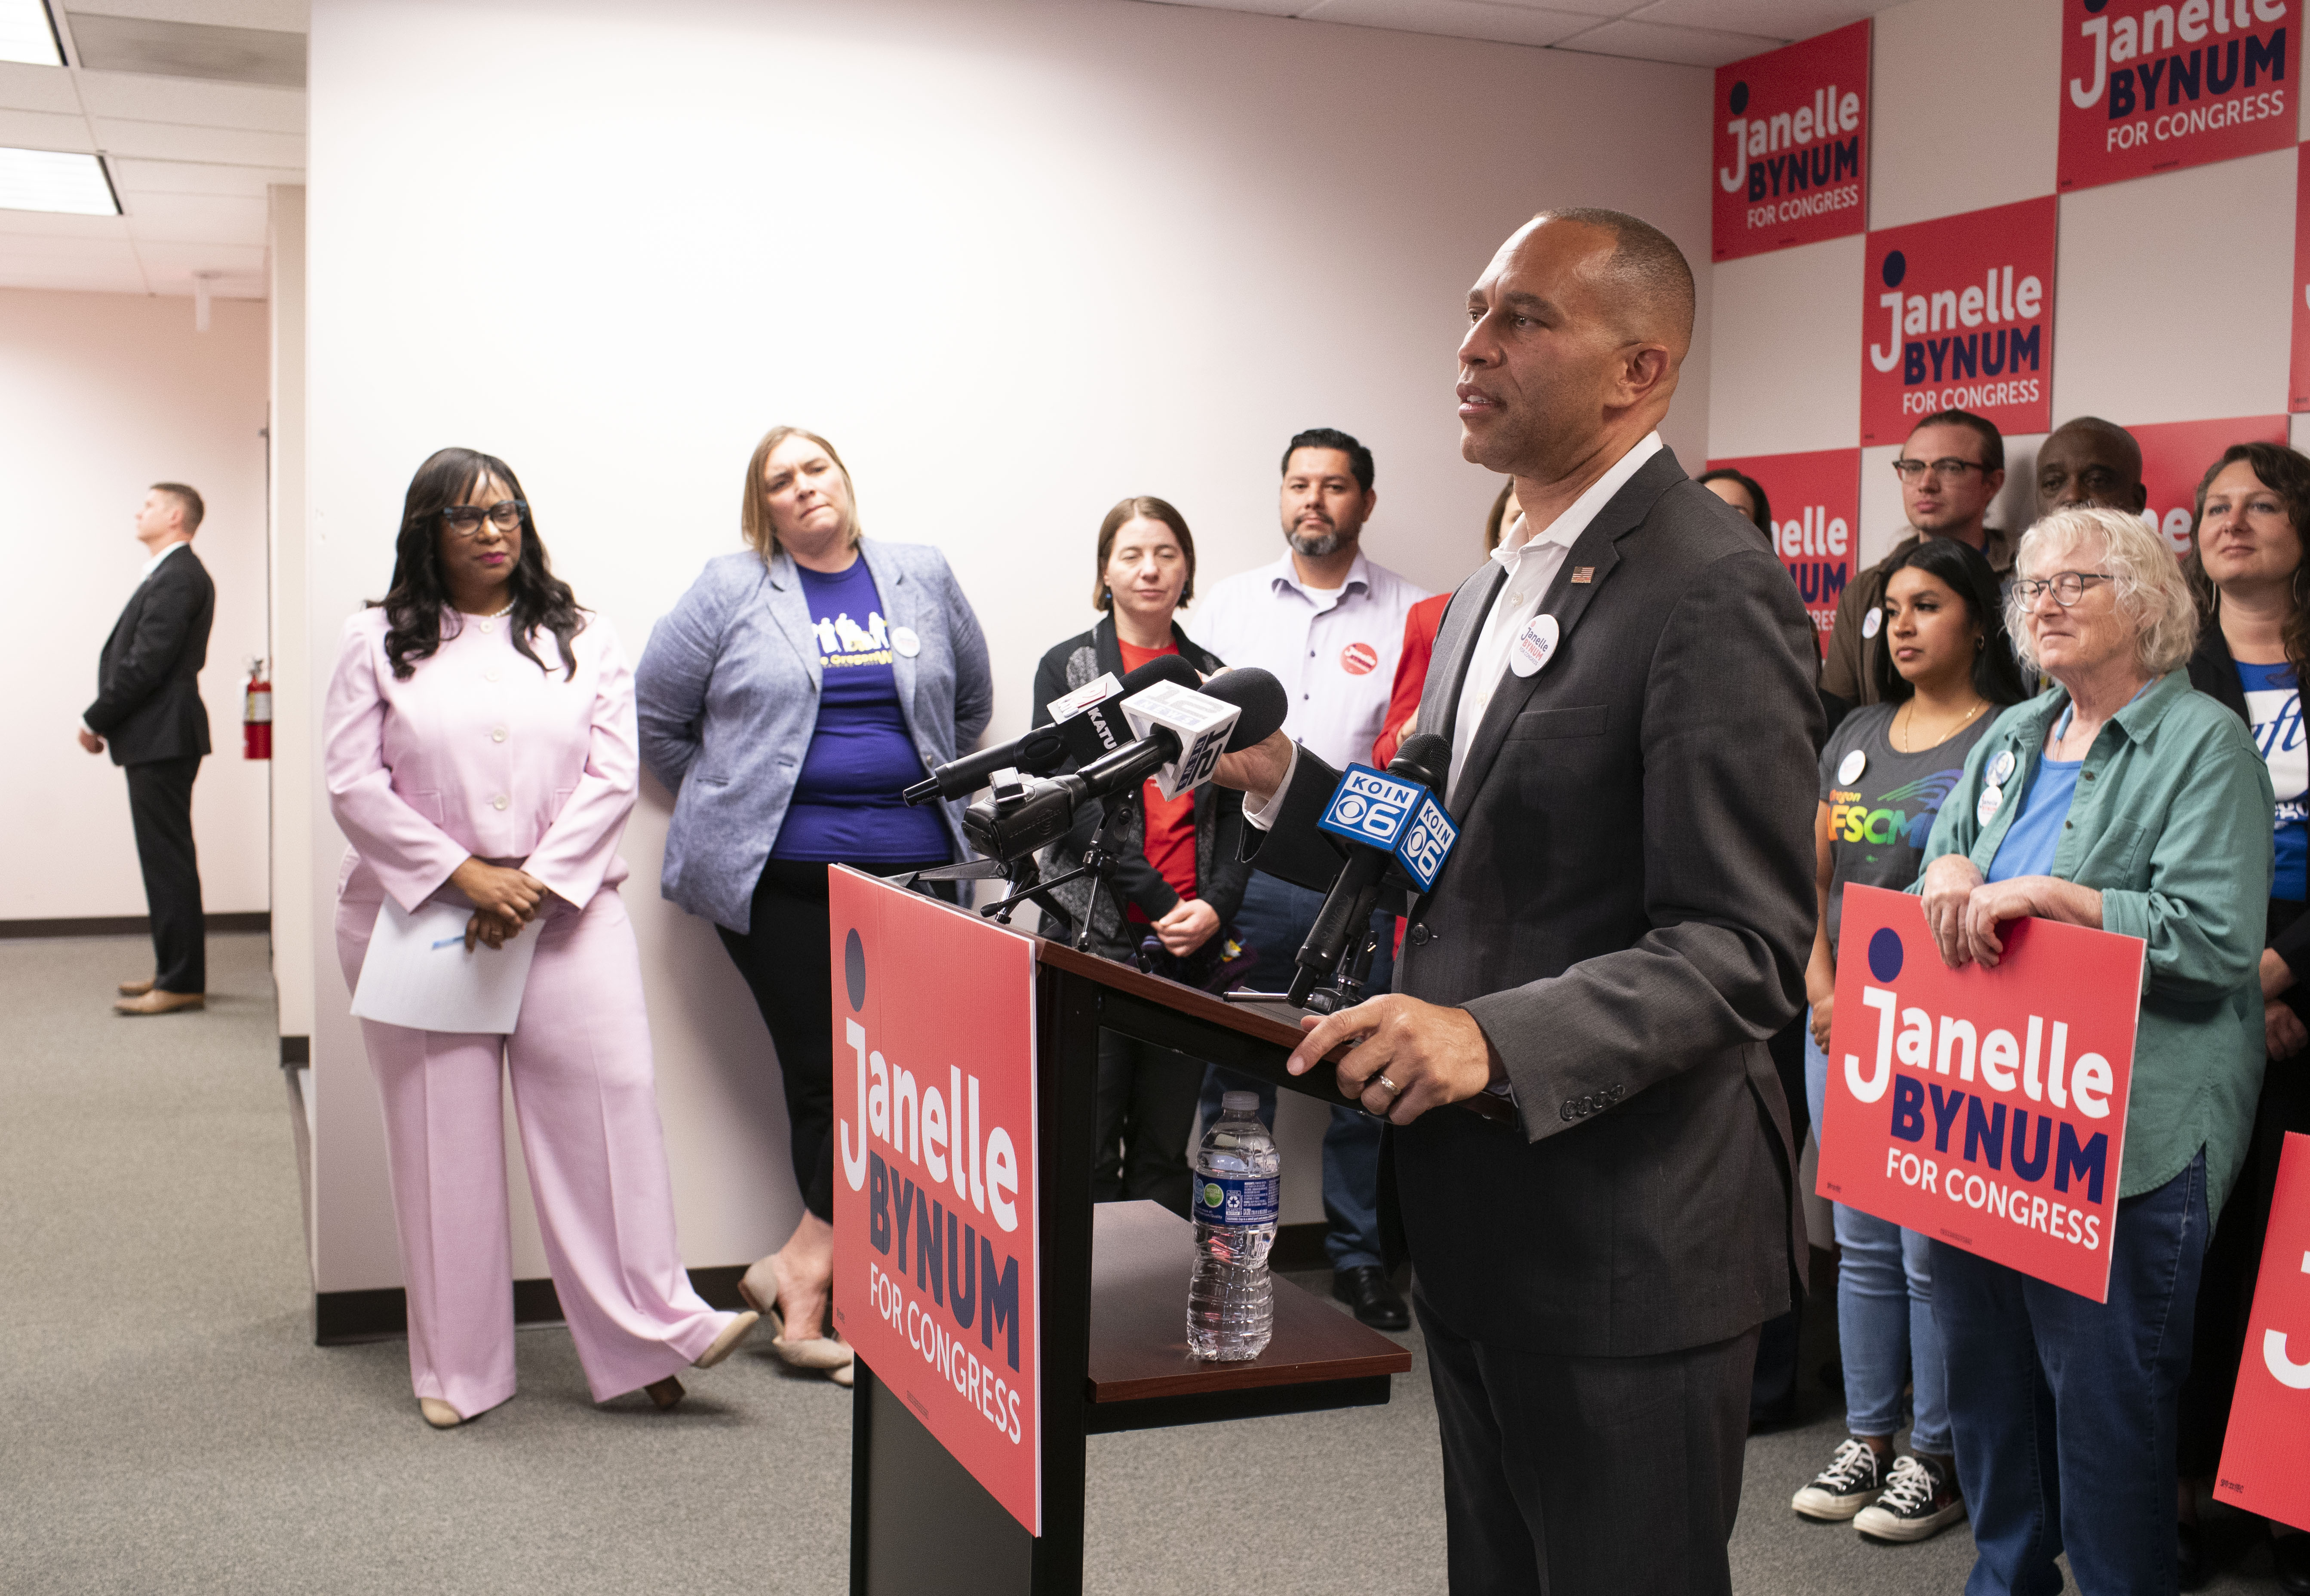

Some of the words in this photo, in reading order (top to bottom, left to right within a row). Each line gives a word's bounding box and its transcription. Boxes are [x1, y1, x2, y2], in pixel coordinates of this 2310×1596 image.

[2110, 28, 2286, 119] BYNUM
[1721, 82, 1859, 192] Janelle
[2107, 122, 2148, 152] FOR
[2155, 90, 2284, 140] CONGRESS
[1749, 137, 1858, 202] BYNUM
[1748, 205, 1776, 228] FOR
[1779, 185, 1858, 222] CONGRESS
[1871, 251, 2042, 372] Janelle
[1905, 325, 2040, 385] BYNUM
[1903, 388, 1937, 414] FOR
[1941, 379, 2039, 411] CONGRESS
[1521, 621, 1548, 652] Janelle
[1522, 638, 1544, 661] BYNUM
[1524, 651, 1539, 666] CONGRESS
[1087, 707, 1117, 750] KATU
[1138, 700, 1195, 724] NEWS
[1145, 685, 1225, 720] 12
[1179, 742, 1204, 787] NEWS
[1187, 720, 1234, 786] 12
[1352, 776, 1410, 804] KOIN
[1362, 803, 1401, 837] 6
[1423, 806, 1451, 845] KOIN
[1418, 839, 1442, 877] 6
[1844, 928, 2113, 1118] Janelle
[840, 929, 1018, 1232] Janelle
[1891, 1074, 2108, 1204] BYNUM
[1887, 1147, 1938, 1194] FOR
[1945, 1168, 2100, 1250] CONGRESS
[871, 1152, 1020, 1373] BYNUM
[871, 1262, 903, 1336] FOR
[908, 1301, 1022, 1445] CONGRESS
